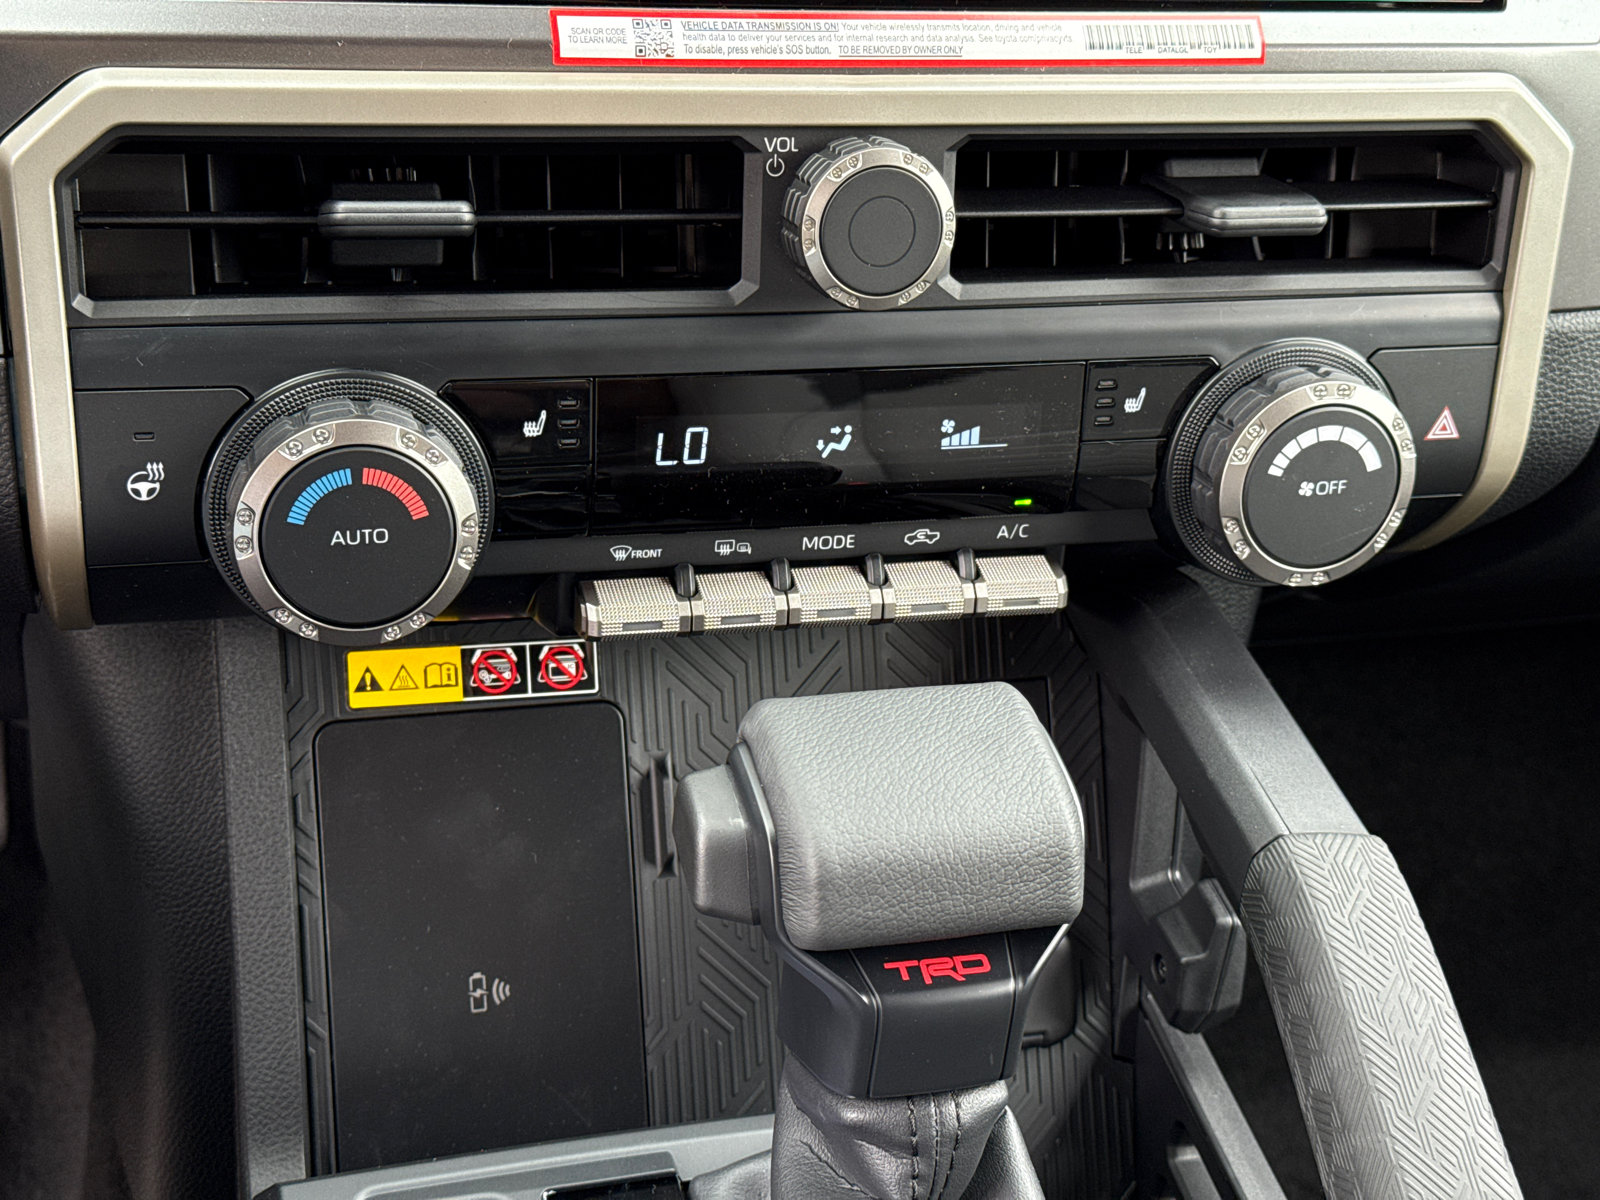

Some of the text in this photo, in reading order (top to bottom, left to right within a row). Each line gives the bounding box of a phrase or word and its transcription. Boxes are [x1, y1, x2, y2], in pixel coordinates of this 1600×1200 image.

[571, 27, 591, 35] SCAN
[605, 28, 626, 36] CODE
[681, 21, 1062, 34] VEHICLE DATA TRANSMISSION IS ON! Your vehicle wirelessly transmits location, driving and vehicle
[568, 35, 628, 44] TO LEARN MORE
[682, 32, 707, 41] health
[708, 33, 726, 41] data
[728, 33, 736, 41] to
[738, 33, 763, 41] deliver
[765, 34, 782, 44] your
[785, 33, 816, 42] services
[818, 33, 832, 42] and
[834, 33, 844, 42] for
[845, 33, 874, 42] internal
[876, 33, 908, 42] research
[911, 33, 924, 42] and
[926, 33, 943, 42] data
[944, 33, 977, 44] analysis.
[978, 34, 993, 42] See
[684, 43, 964, 57] To disable, press vehicle's SOS button. TO BE REMOVED BY OWNER ONLY
[763, 136, 799, 153] VOL
[1315, 479, 1348, 496] OFF
[330, 527, 389, 547] AUTO
[996, 523, 1030, 540] A/C
[802, 534, 856, 550] MODE
[630, 548, 663, 559] FRONT
[883, 953, 992, 985] TRD
